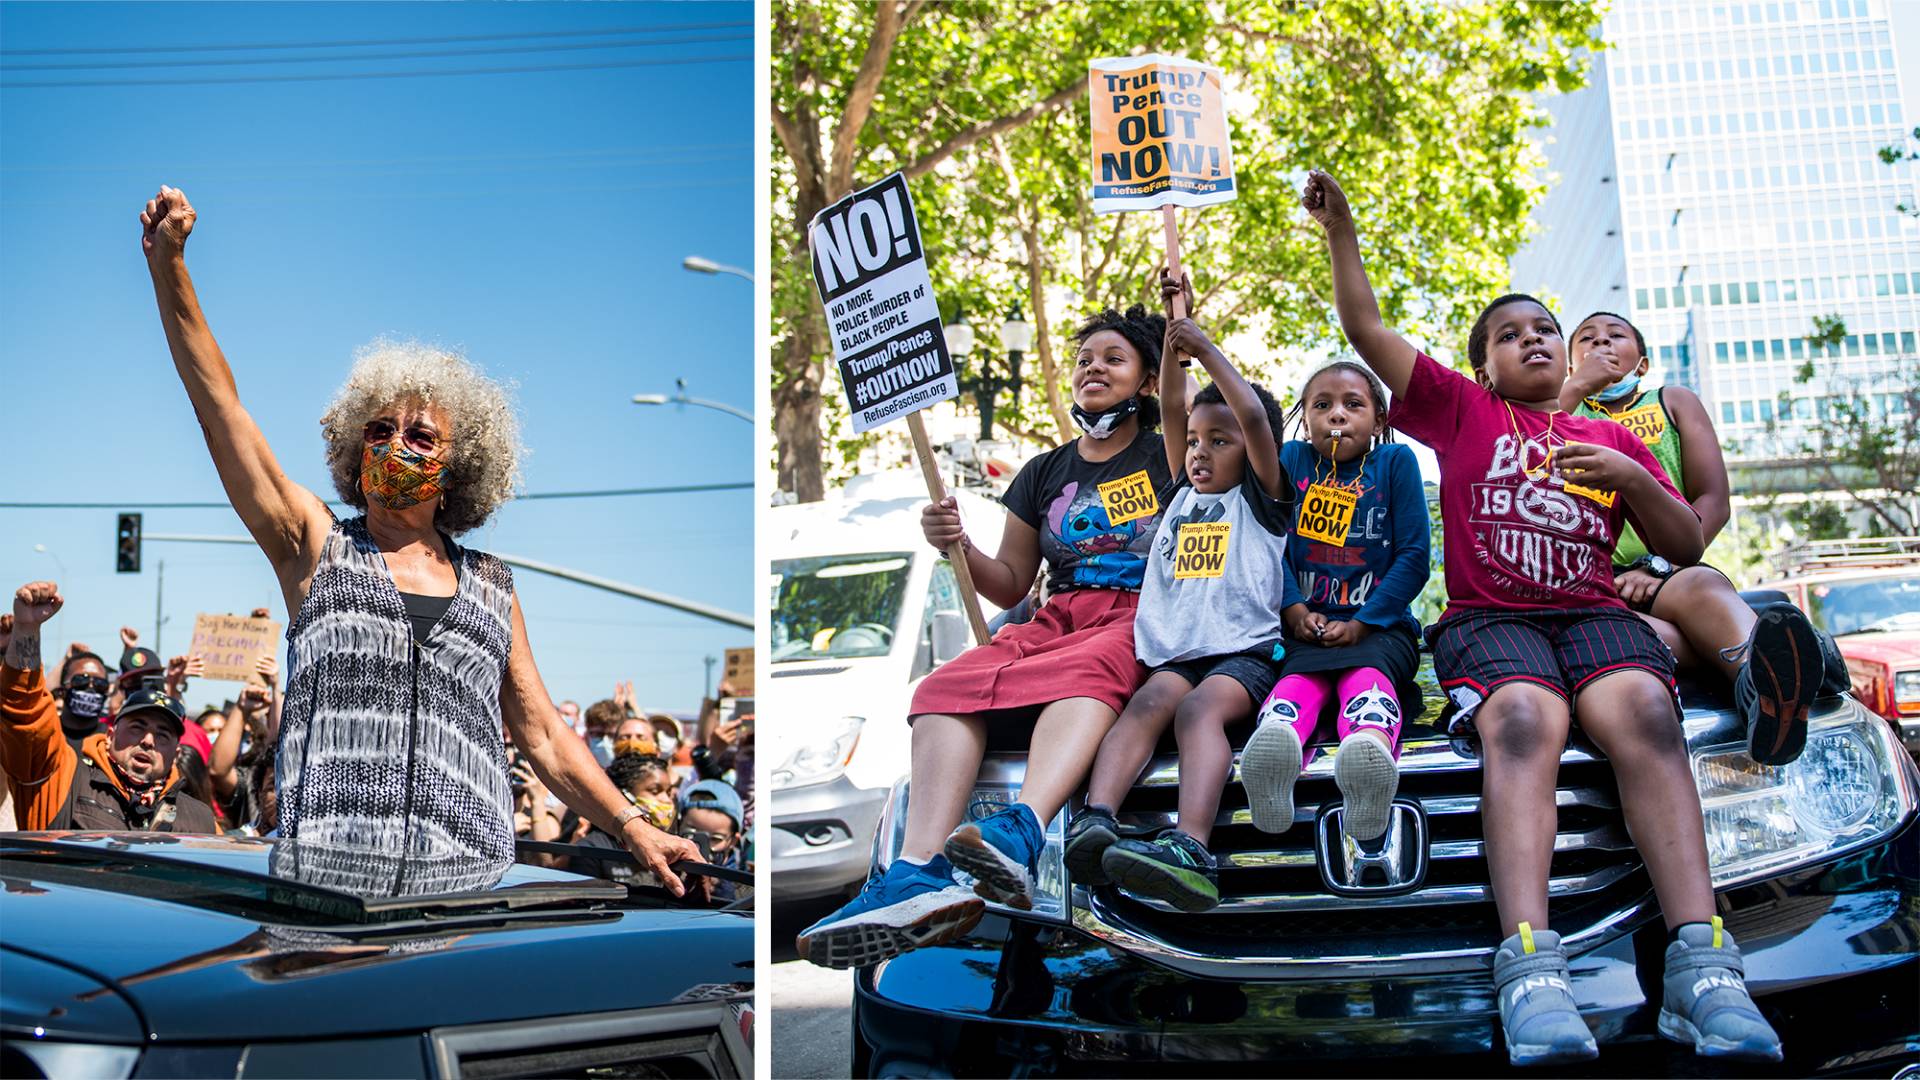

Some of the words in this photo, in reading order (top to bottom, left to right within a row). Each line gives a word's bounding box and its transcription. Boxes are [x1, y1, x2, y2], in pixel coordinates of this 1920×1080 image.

[1103, 70, 1206, 92] Trump/
[1113, 90, 1202, 113] Pence
[1118, 108, 1201, 146] OUT
[1101, 142, 1221, 182] NOW!
[1111, 178, 1217, 195] RefuseFascism.org
[813, 186, 912, 293] NO!
[831, 302, 846, 319] NO
[847, 289, 874, 315] MORE
[836, 310, 869, 335] POLICE
[869, 295, 911, 323] MURDER
[913, 284, 925, 300] of
[840, 328, 873, 352] BLACK
[872, 311, 909, 339] PEOPLE
[848, 329, 934, 377] Trump/Pence
[855, 349, 941, 406] #OUTNOW
[863, 381, 947, 424] RefuseFascism.org
[1620, 411, 1656, 428] OUT
[1633, 423, 1663, 438] OW
[1099, 473, 1146, 493] Trump/Pence
[1108, 481, 1145, 504] OUT
[1108, 494, 1154, 520] NOW
[1308, 497, 1349, 520] OUT
[1480, 488, 1512, 515] 19
[1181, 524, 1230, 534] Trump/Pence
[1300, 513, 1348, 539] NOW
[1183, 535, 1223, 553] OUT
[1177, 553, 1225, 572] NOW
